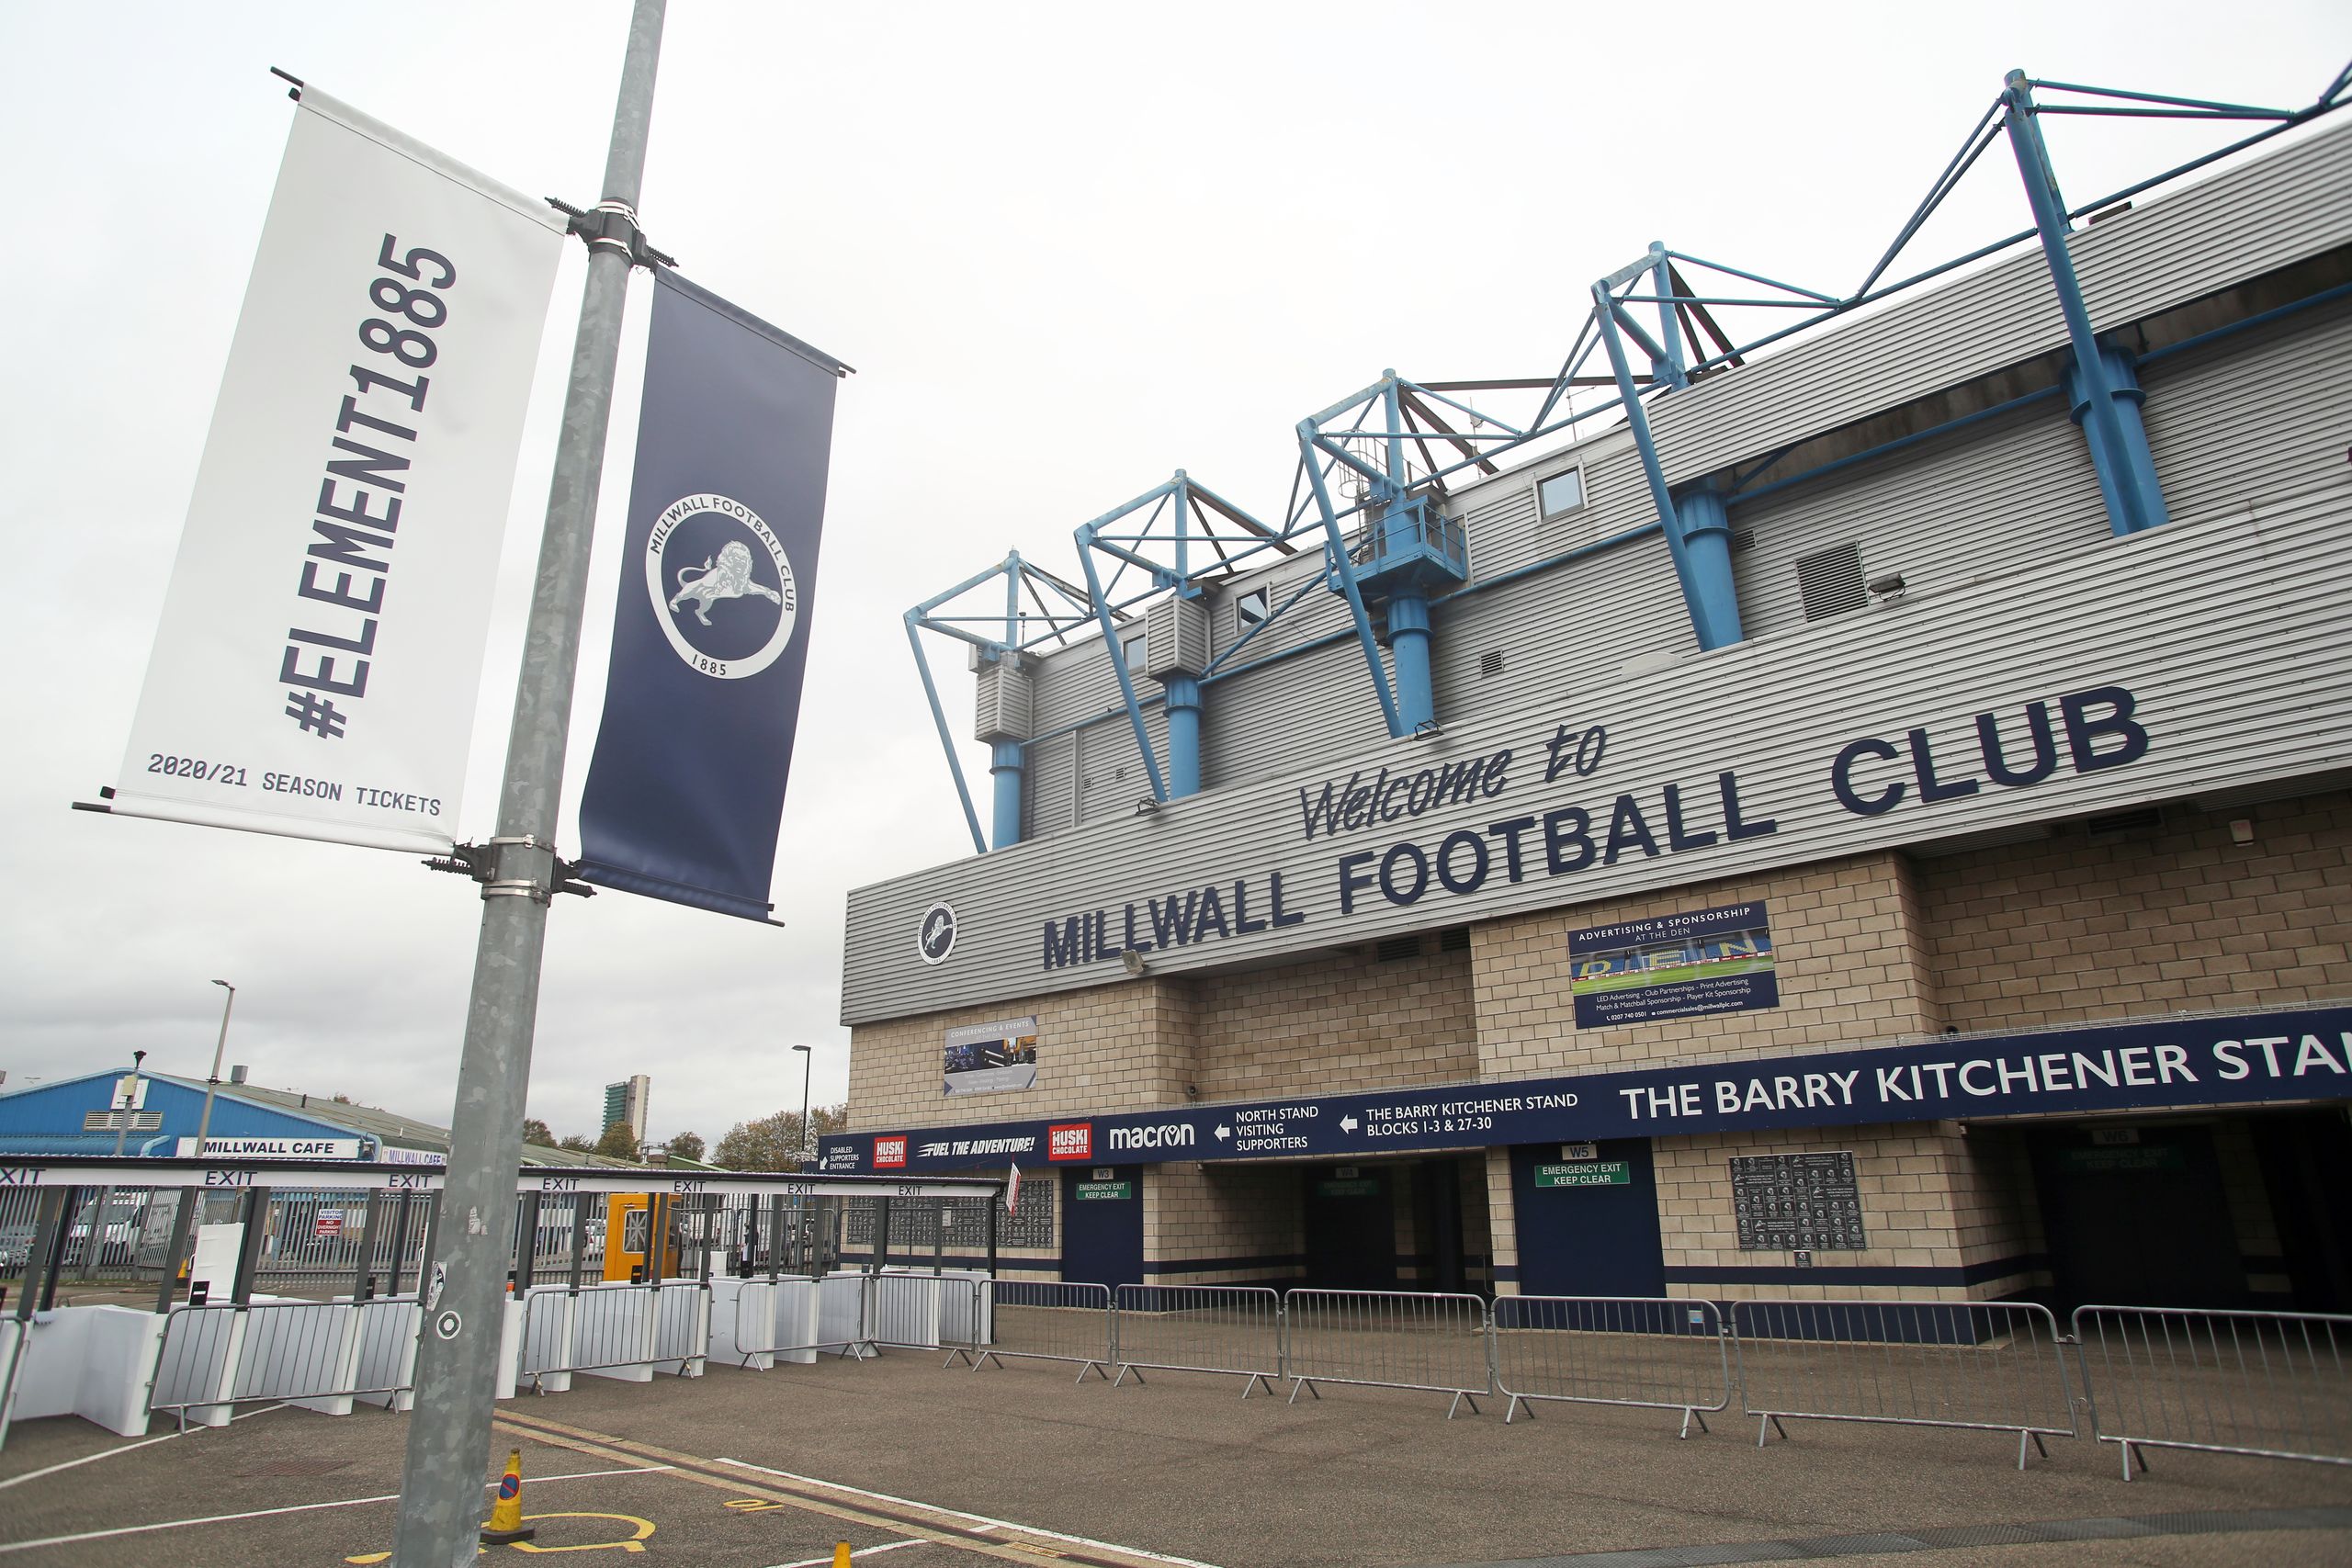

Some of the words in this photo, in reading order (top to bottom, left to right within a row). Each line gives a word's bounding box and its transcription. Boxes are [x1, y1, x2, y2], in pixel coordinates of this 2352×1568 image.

[278, 232, 457, 739] #ELEMENT1885
[650, 497, 709, 554] MILLWALL
[713, 497, 782, 560] FOOTBALL
[780, 565, 794, 612] CLUB
[693, 654, 727, 676] 1885
[148, 753, 247, 786] 2020/21
[263, 773, 343, 801] SEASON
[356, 786, 441, 817] TICKETS
[1300, 749, 1512, 840] Welcome
[1544, 724, 1606, 784] to
[1043, 872, 1305, 970] MILLWALL
[1339, 770, 1777, 916] FOOTBALL
[1832, 685, 2150, 816] CLUB
[1578, 923, 1652, 942] ADVERTISING
[1657, 921, 1664, 930] &
[1668, 908, 1750, 927] SPONSORSHIP
[1635, 933, 1647, 942] AT
[1649, 931, 1667, 940] THE
[1670, 927, 1690, 937] DEN
[1609, 991, 1641, 1002] Advertising
[1645, 988, 1658, 997] Club
[1659, 985, 1695, 996] Partnerships
[1700, 982, 1713, 990] Print
[1714, 978, 1749, 989] Advertising
[1596, 1003, 1612, 1011] Match
[1620, 999, 1645, 1009] Matchball
[1647, 996, 1681, 1007] Sponsorship
[1686, 992, 1704, 1003] Player
[1705, 990, 1713, 998] Kit
[1714, 987, 1751, 998] Sponsorship
[1611, 1013, 1623, 1021] 0207
[950, 1025, 997, 1038] CONFERENCING
[1005, 1021, 1029, 1030] EVENTS
[1620, 1083, 1702, 1121] THE
[1713, 1069, 1860, 1114] BARRY
[1876, 1044, 2199, 1104] KITCHENER
[1236, 1109, 1276, 1122] NORTH
[1278, 1106, 1319, 1120] STAND
[1366, 1108, 1392, 1122] THE
[1396, 1104, 1439, 1120] BARRY
[1442, 1098, 1522, 1116] KITCHENER
[1526, 1093, 1578, 1110] STAND
[1236, 1123, 1284, 1136] VISITING
[1367, 1122, 1419, 1137] BLOCKS
[1422, 1119, 1441, 1134] 1-3
[1444, 1119, 1454, 1133] &
[1457, 1116, 1493, 1132] 27-30
[1052, 1129, 1088, 1146] HUSKI
[1109, 1123, 1195, 1150] macron
[1237, 1136, 1308, 1151] SUPPORTERS
[2102, 1131, 2129, 1142] W6
[203, 1142, 287, 1153] MILLWALL
[292, 1143, 334, 1154] CAFE
[831, 1146, 853, 1155] DISABLED
[876, 1141, 904, 1156] HUSKI
[952, 1141, 969, 1155] THE
[970, 1137, 1035, 1155] ADVENTURE!
[1052, 1145, 1088, 1155] CHOCOLATE
[1570, 1147, 1589, 1157] W5
[830, 1154, 860, 1162] SUPPORTERS
[876, 1155, 903, 1163] CHOCOLATE
[830, 1162, 855, 1170] ENTRANCE
[1543, 1165, 1599, 1175] EMERGENCY
[1601, 1164, 1621, 1172] EXIT
[205, 1171, 257, 1185] EXIT
[390, 1174, 433, 1188] EXIT
[1098, 1169, 1109, 1179] W3
[1554, 1177, 1577, 1185] KEEP
[1580, 1175, 1611, 1183] CLEAR
[543, 1179, 580, 1190] EXIT
[674, 1181, 706, 1192] EXIT
[787, 1183, 815, 1194] EXIT
[899, 1185, 922, 1196] EXIT
